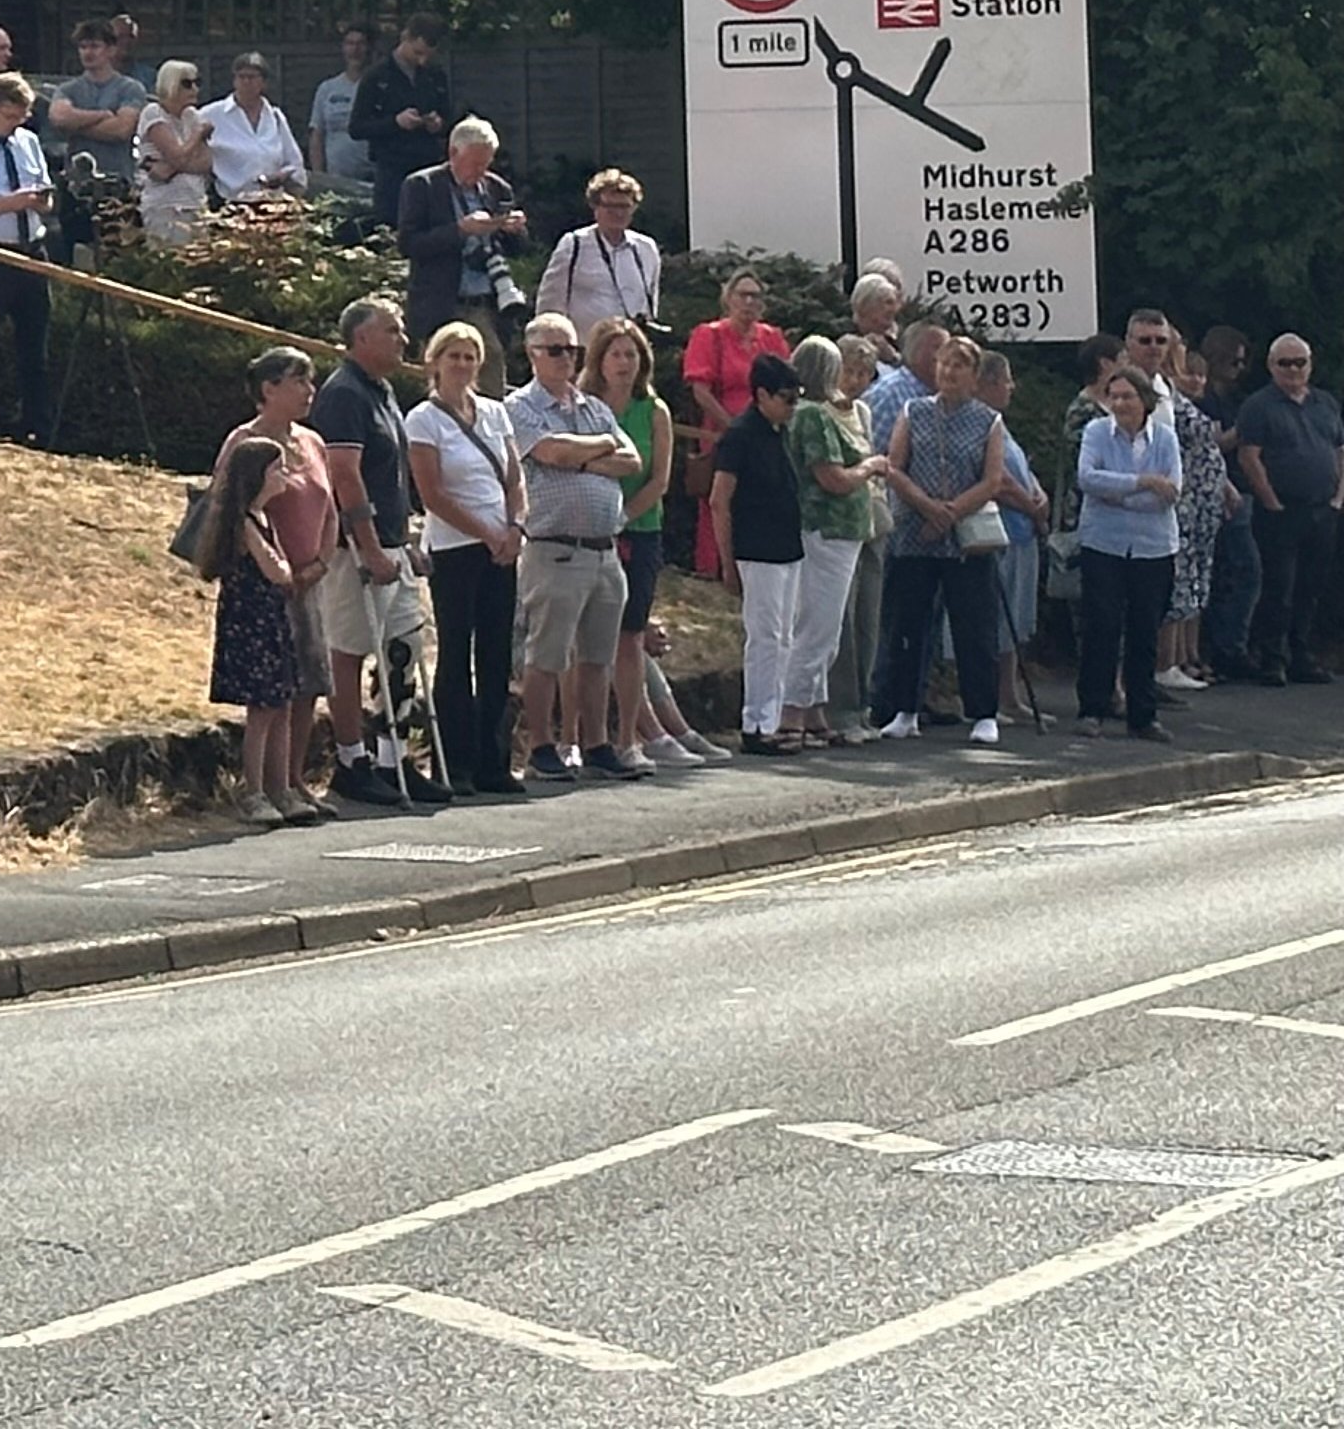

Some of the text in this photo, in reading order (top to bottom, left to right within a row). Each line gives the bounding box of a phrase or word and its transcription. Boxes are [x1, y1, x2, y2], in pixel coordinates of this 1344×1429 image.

[730, 31, 798, 54] 1 mile
[922, 162, 1059, 190] Midhurst
[923, 227, 1010, 255] A286
[926, 267, 1065, 295] Petworth
[949, 298, 1051, 332] A283)
